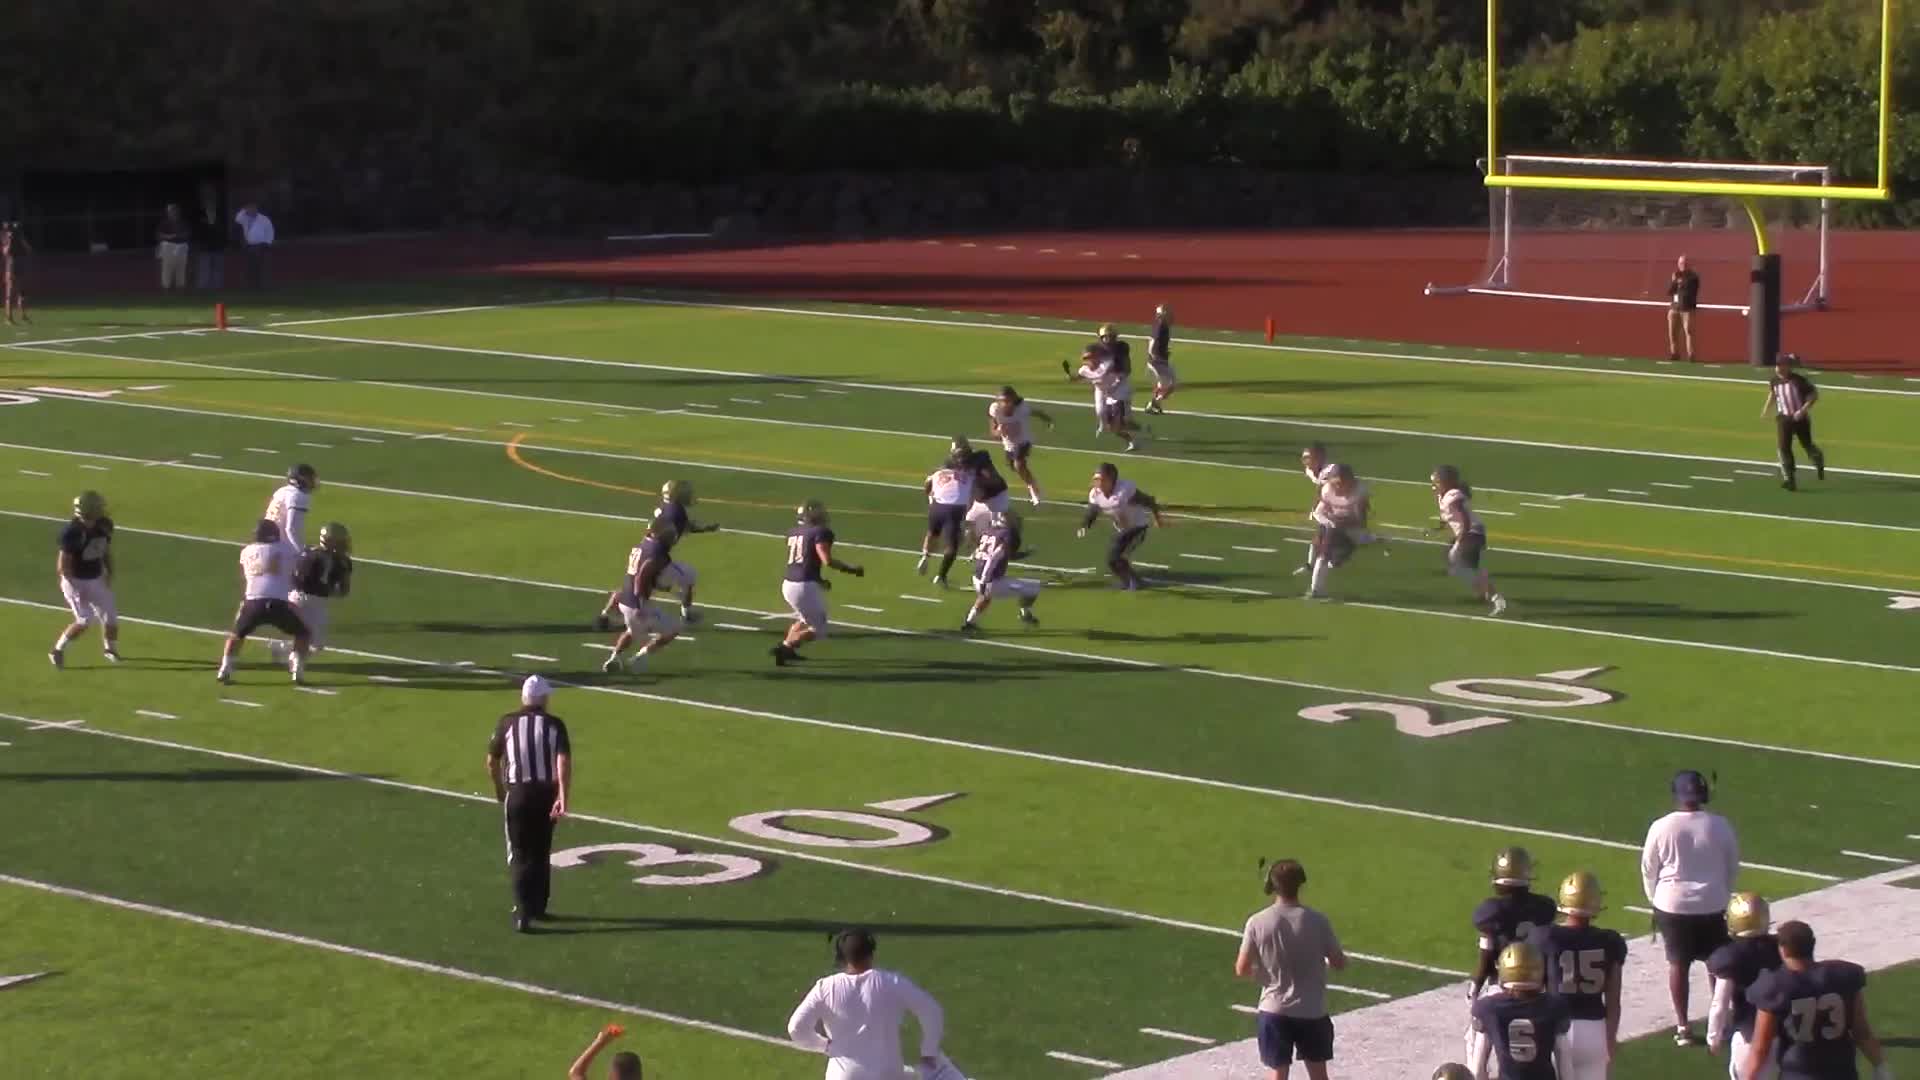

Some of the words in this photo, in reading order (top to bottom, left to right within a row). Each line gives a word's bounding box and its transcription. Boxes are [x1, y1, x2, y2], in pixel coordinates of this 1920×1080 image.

[1297, 677, 1614, 738] 20
[550, 808, 935, 887] 30
[1558, 948, 1606, 994] 15
[1784, 992, 1847, 1042] 73
